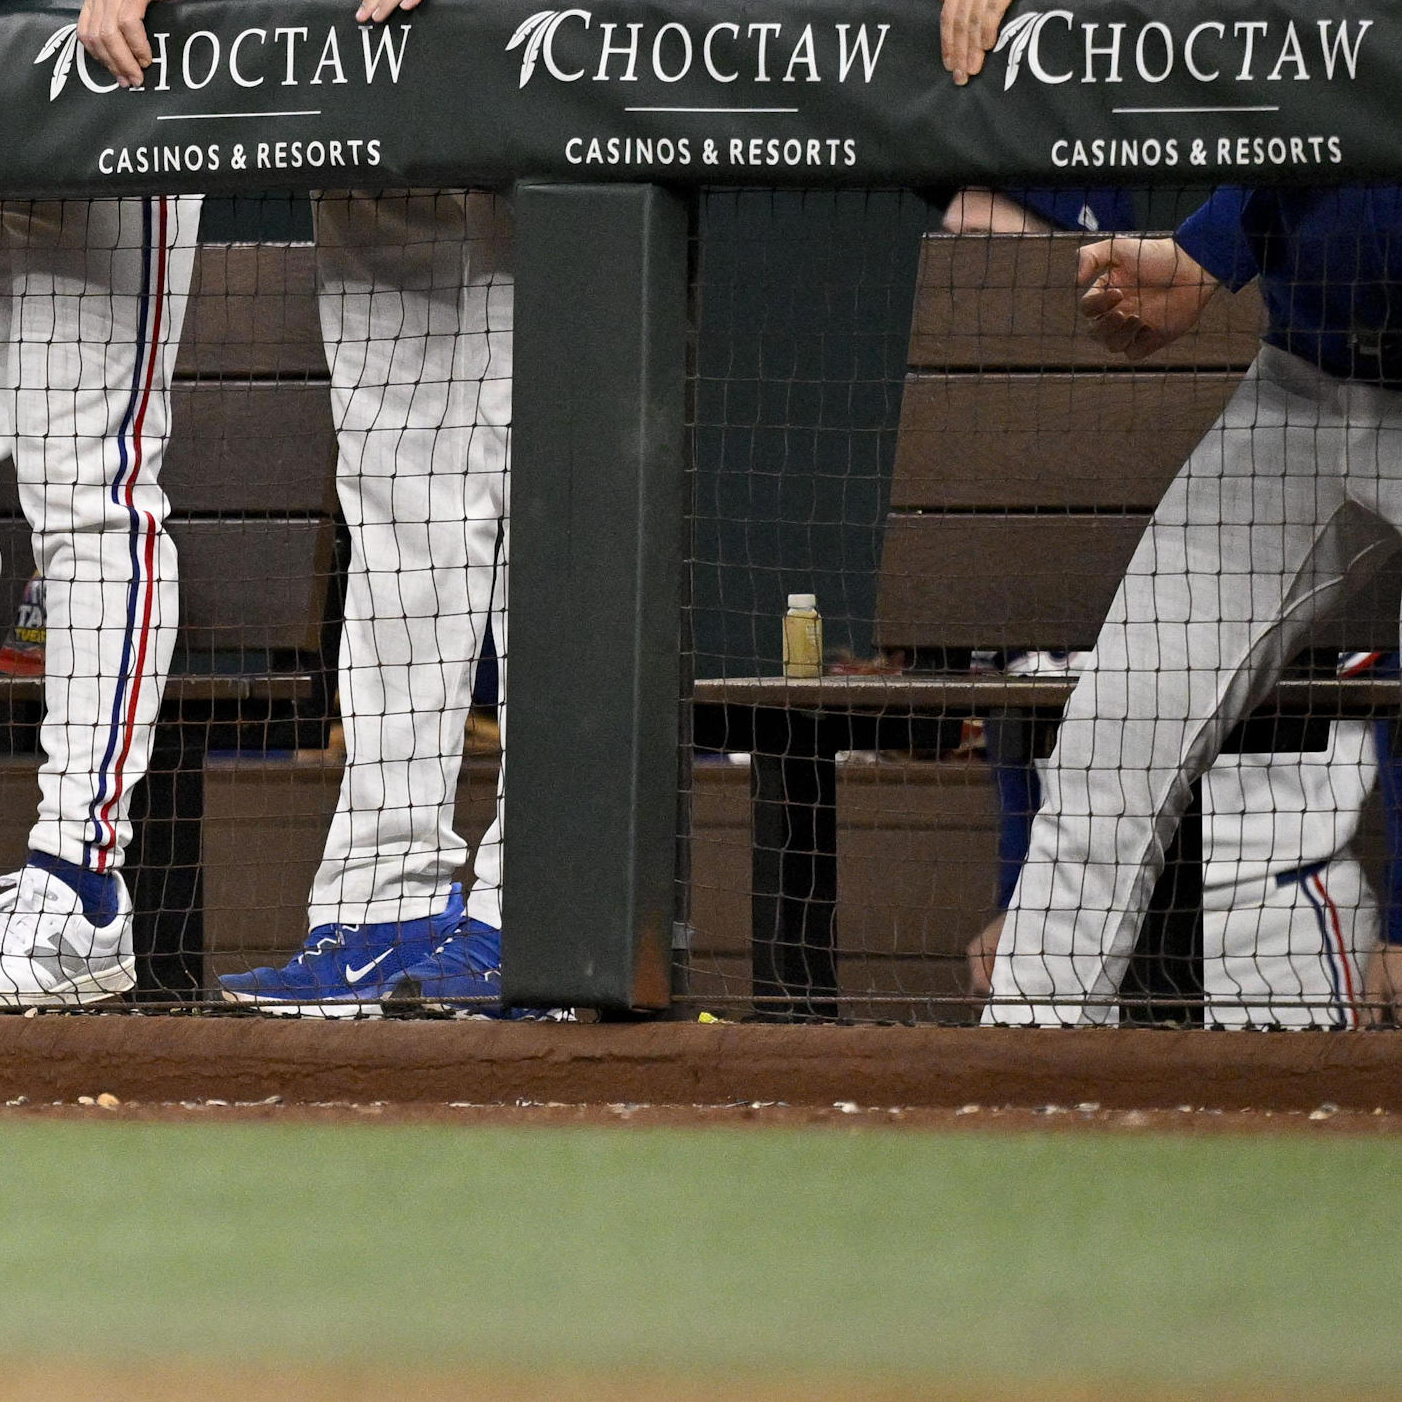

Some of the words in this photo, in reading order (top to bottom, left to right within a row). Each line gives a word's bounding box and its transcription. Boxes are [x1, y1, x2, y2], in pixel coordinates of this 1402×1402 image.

[542, 8, 891, 84] CHOCTAW
[1027, 9, 1374, 85] CHOCTAW
[98, 144, 220, 175] CASINOS
[230, 143, 247, 170] &
[256, 139, 382, 169] RESORTS
[564, 137, 692, 165] CASINOS
[702, 138, 719, 165] &
[729, 138, 857, 166] RESORTS
[1051, 138, 1179, 167] CASINOS
[1189, 138, 1207, 166] &
[1217, 136, 1343, 165] RESORTS
